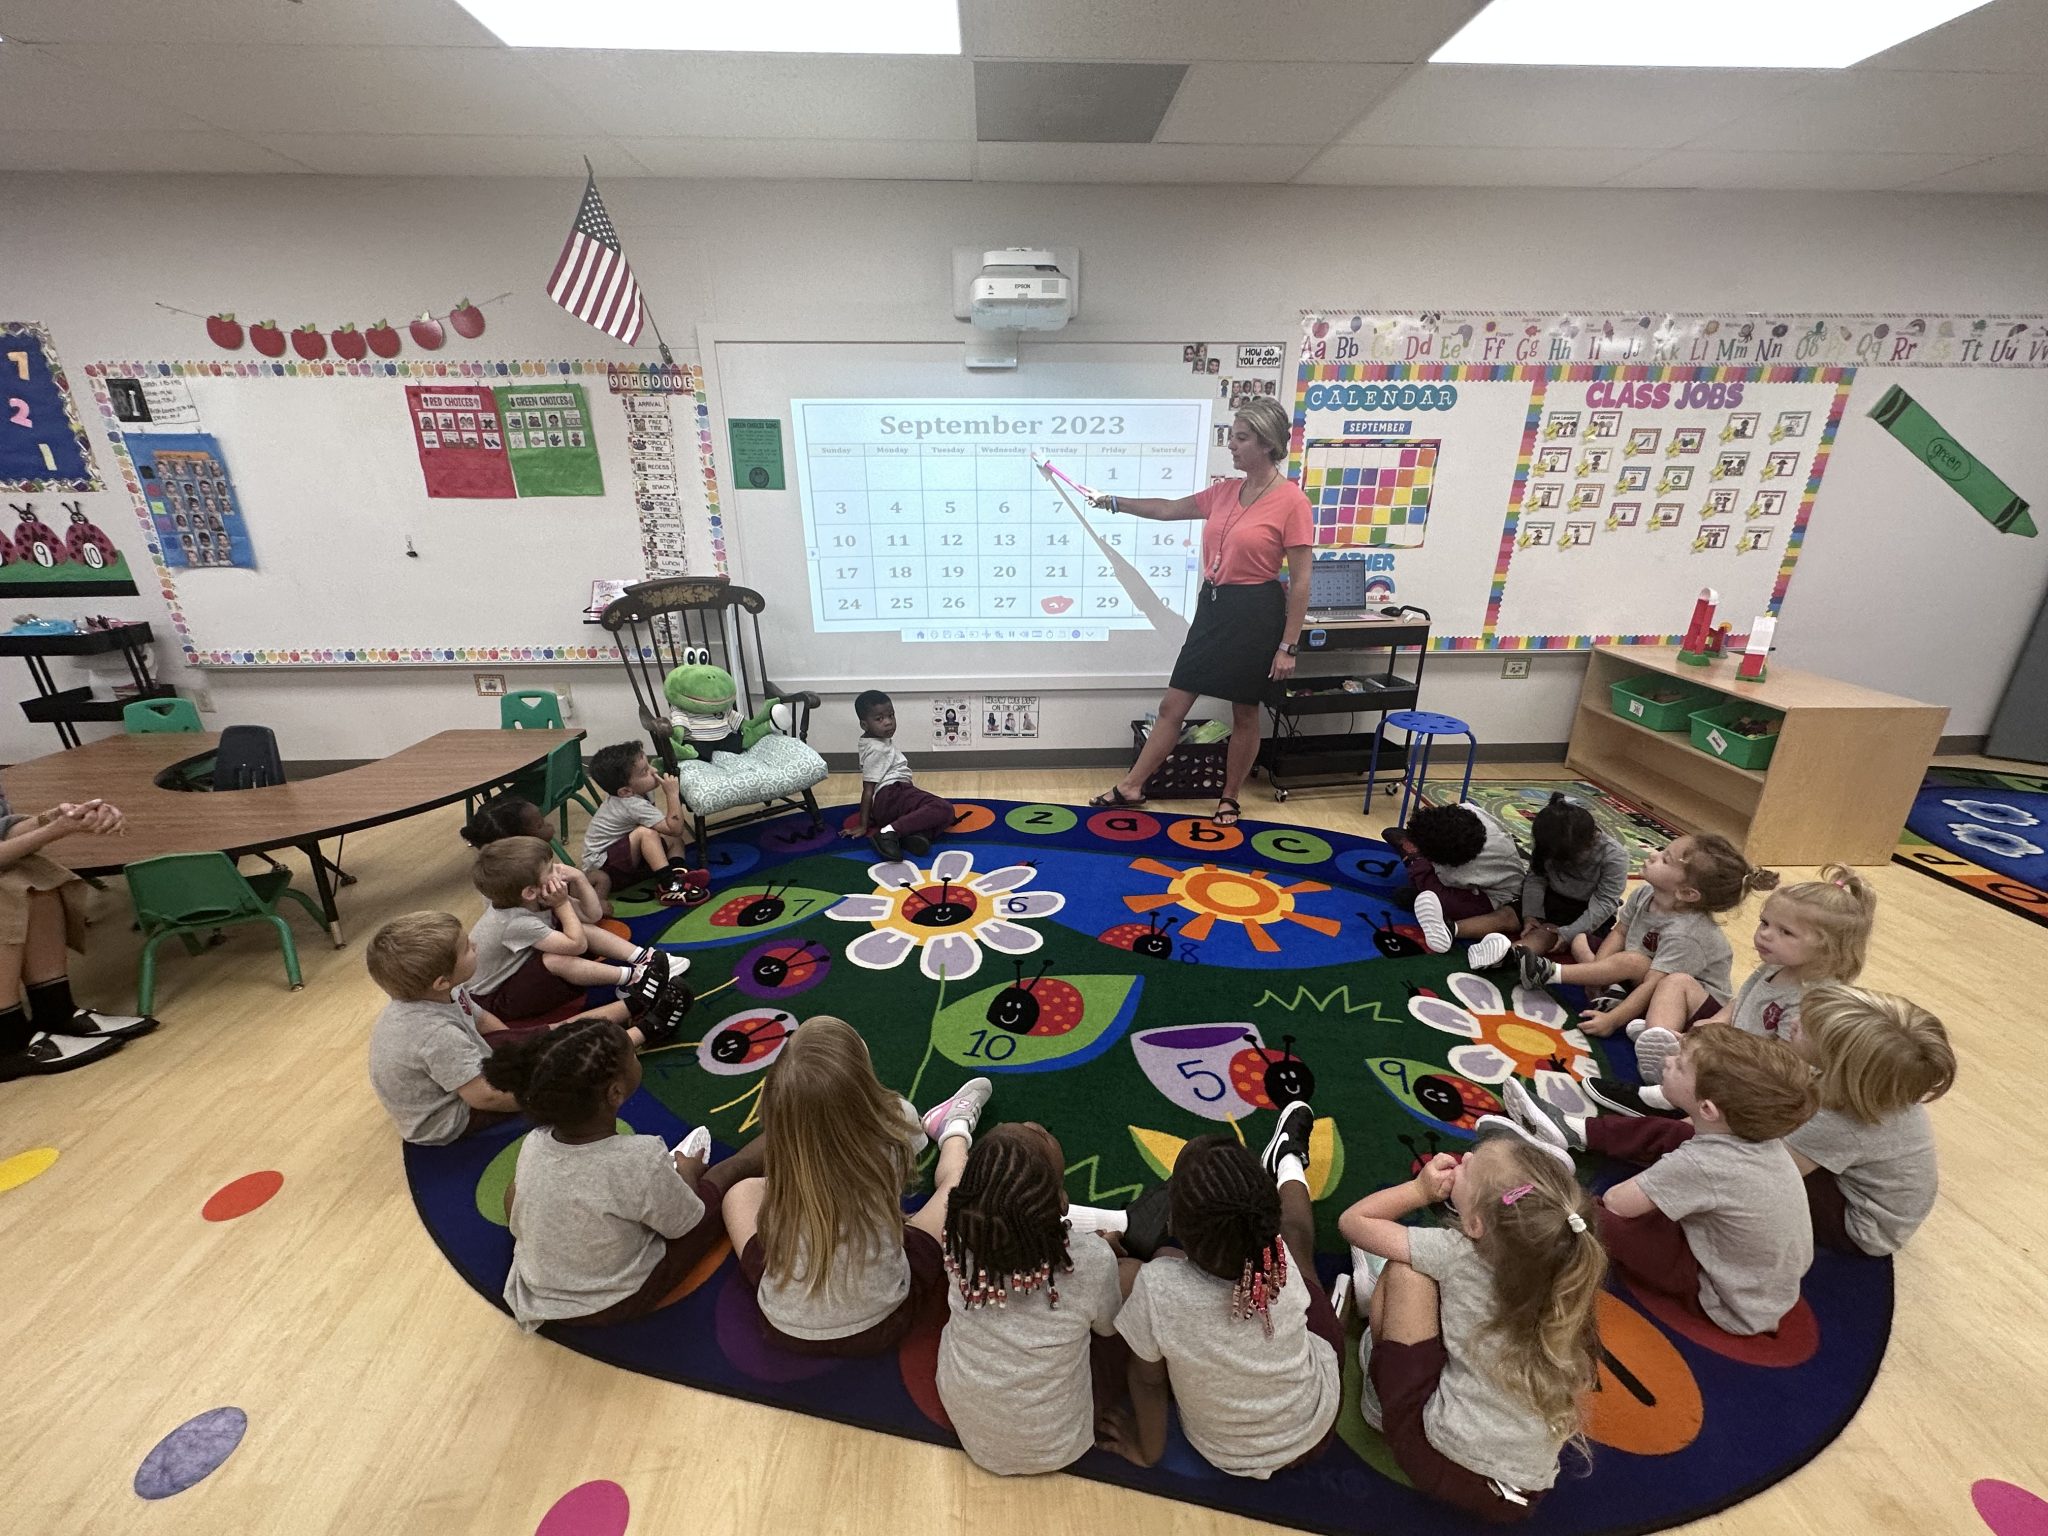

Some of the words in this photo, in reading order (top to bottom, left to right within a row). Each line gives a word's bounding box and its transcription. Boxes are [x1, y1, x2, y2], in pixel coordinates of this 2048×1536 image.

[1301, 335, 1327, 360] Aa
[1335, 336, 1359, 359] Bb
[1404, 333, 1433, 360] Dd
[1440, 335, 1461, 359] Ee
[1483, 337, 1506, 360] Ff
[1516, 338, 1540, 360] Gg
[1548, 338, 1572, 360] Hh
[1690, 337, 1709, 360] Ll
[1716, 338, 1748, 361] Mm
[1755, 338, 1783, 361] Nn
[1795, 337, 1819, 360] Oo
[1856, 333, 1883, 362] Qq
[1890, 337, 1918, 362] Rr
[1961, 339, 1983, 362] Tt
[1989, 339, 2019, 362] Uu
[7, 351, 30, 380] 7
[611, 375, 692, 388] SCHEDULE
[429, 396, 442, 407] RED
[444, 397, 474, 407] CHOICES
[515, 396, 538, 407] GREEN
[539, 396, 569, 406] CHOICES
[1311, 390, 1453, 406] CALENDAR
[1586, 382, 1671, 409] CLASS
[1674, 382, 1744, 410] JOBS
[9, 397, 33, 428] 2
[880, 415, 1042, 440] September
[1051, 415, 1125, 435] 2023
[1349, 422, 1405, 433] SEPTEMBER
[38, 443, 58, 471] 1
[821, 447, 852, 455] Sunday
[876, 446, 909, 455] Monday
[930, 446, 965, 455] Tuesday
[980, 446, 1027, 455] Wednesday
[1039, 446, 1078, 455] Thursday
[1101, 446, 1127, 455] Friday
[1150, 446, 1187, 455] Saturday
[1928, 443, 1962, 472] green
[1107, 467, 1119, 480] 1
[1160, 467, 1173, 480] 2
[835, 502, 847, 515] 3
[890, 501, 903, 514] 4
[944, 501, 956, 514] 5
[998, 501, 1011, 514] 6
[1052, 501, 1064, 514] 7
[832, 535, 857, 548] 10
[886, 534, 911, 547] 11
[940, 534, 964, 547] 12
[993, 534, 1016, 547] 13
[1046, 534, 1070, 547] 14
[1151, 534, 1175, 547] 16
[35, 544, 49, 565] 9
[84, 547, 102, 565] 10
[835, 567, 859, 580] 17
[889, 566, 913, 579] 18
[941, 566, 965, 579] 19
[993, 565, 1017, 578] 20
[1045, 565, 1069, 578] 21
[1149, 565, 1173, 578] 23
[838, 598, 862, 611] 24
[890, 597, 914, 610] 25
[942, 597, 966, 610] 26
[993, 597, 1017, 609] 27
[1096, 596, 1119, 609] 29
[1025, 811, 1053, 825] z
[1105, 817, 1138, 832] a
[1188, 821, 1226, 843] b
[1272, 837, 1310, 854] c
[1355, 859, 1400, 878] d
[793, 899, 816, 917] 7
[1007, 896, 1028, 913] 6
[1179, 942, 1200, 965] 8
[962, 1029, 1017, 1061] 10
[1176, 1059, 1226, 1102] 5
[1379, 1059, 1410, 1095] 9
